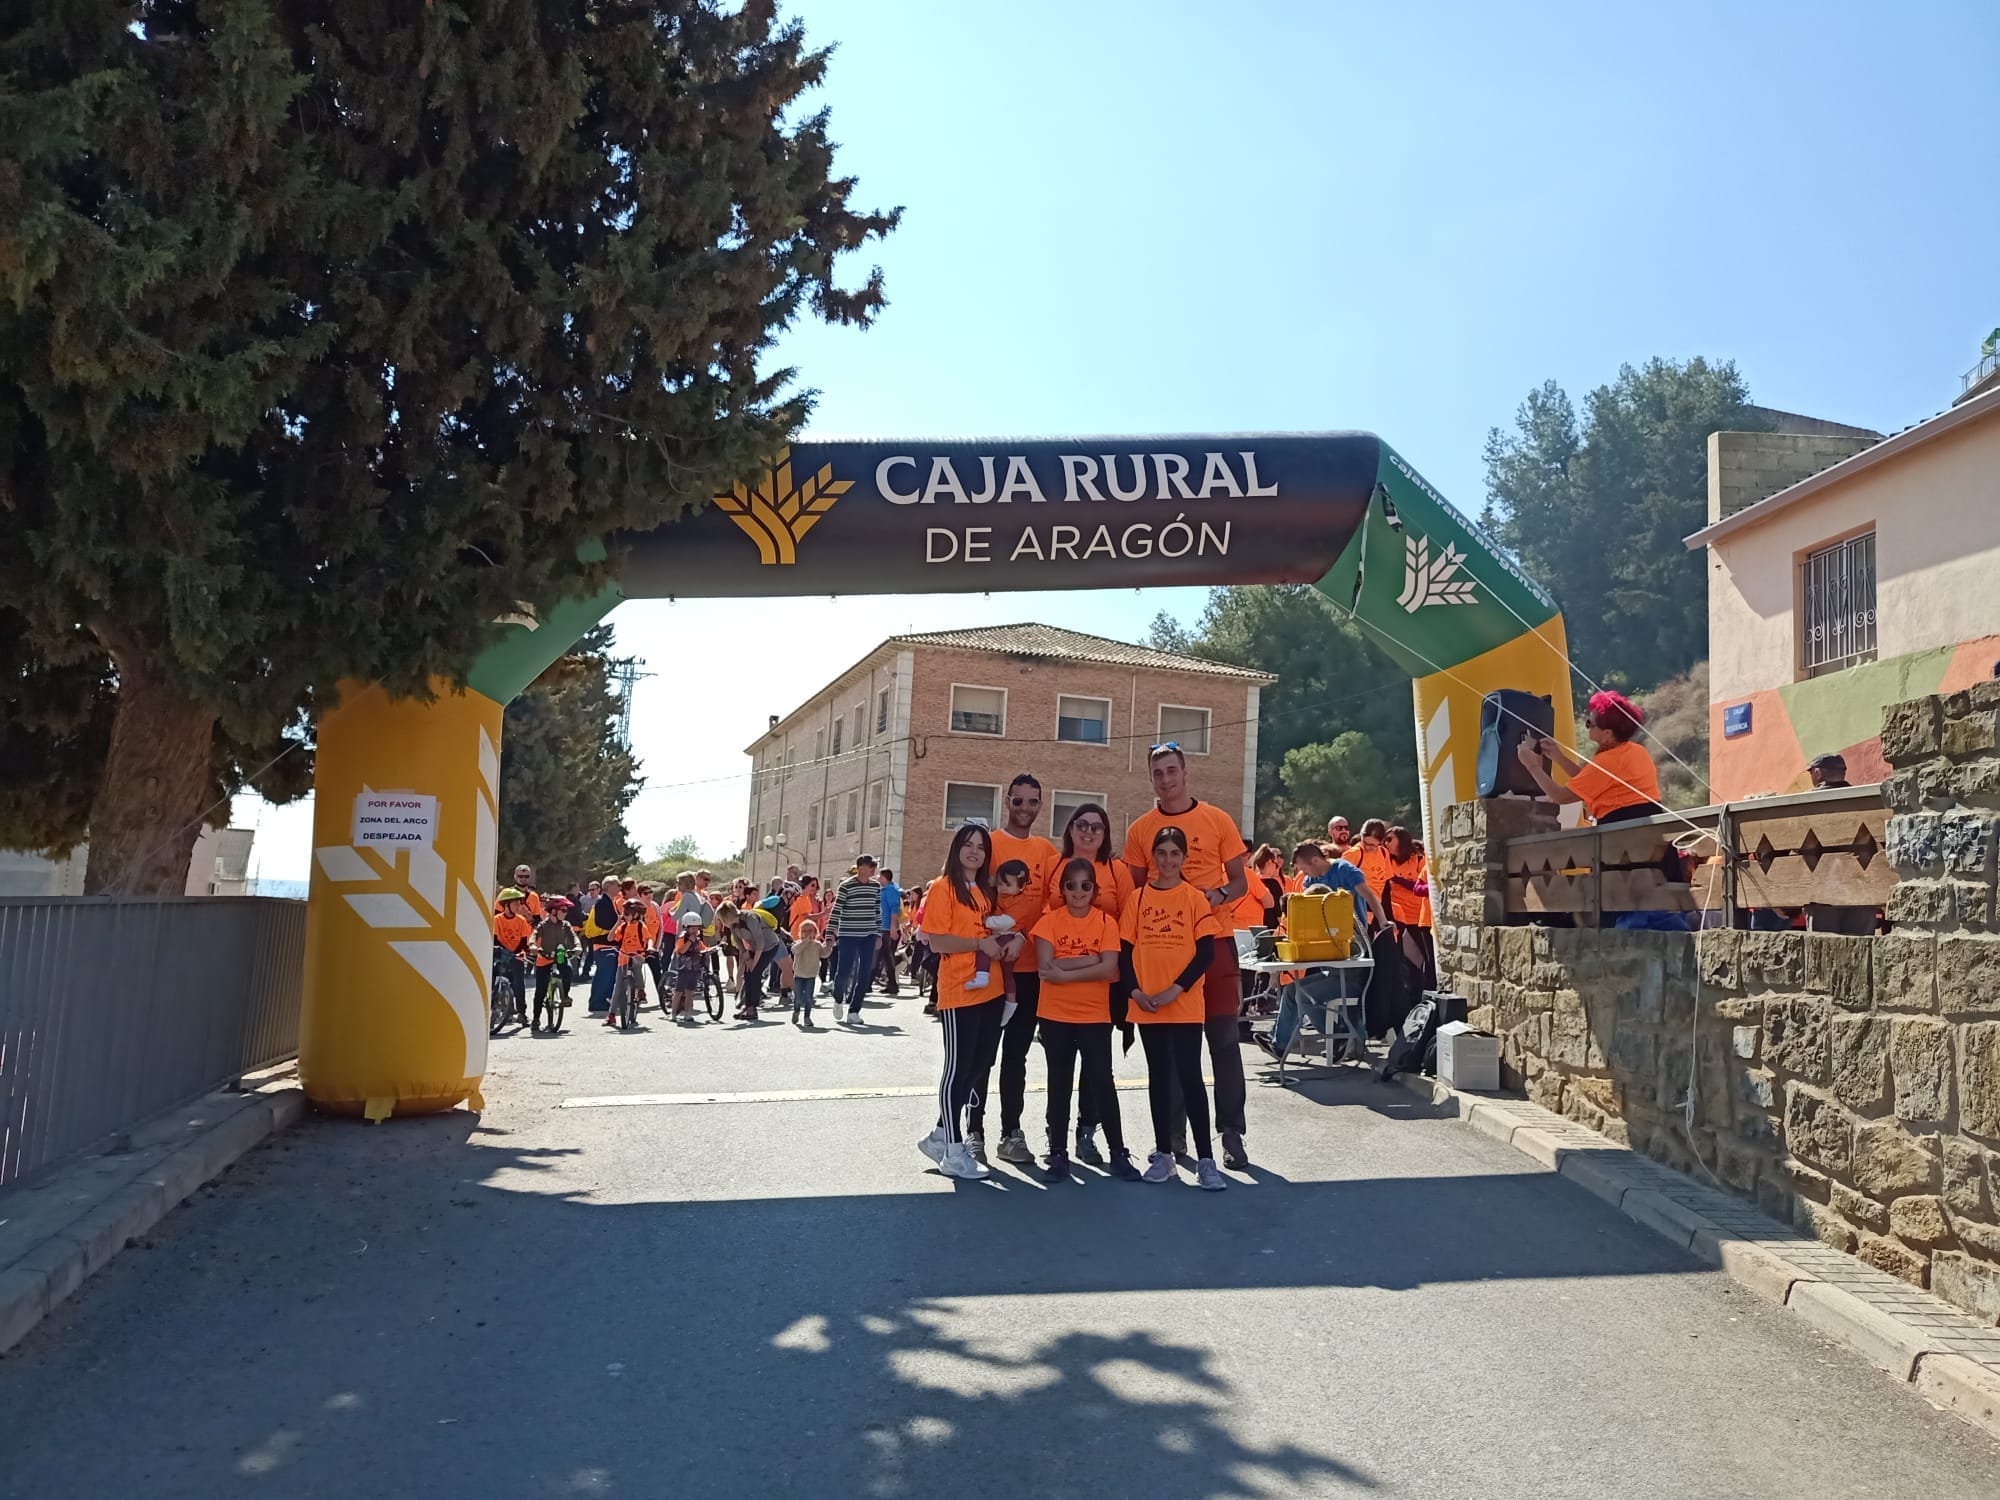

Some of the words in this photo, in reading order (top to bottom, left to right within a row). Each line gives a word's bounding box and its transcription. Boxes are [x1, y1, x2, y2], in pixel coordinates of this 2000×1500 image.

[875, 455, 1045, 505] CAJA
[1059, 450, 1278, 503] RURAL
[925, 526, 992, 563] DE
[1010, 513, 1231, 562] ARAGÓN
[1388, 455, 1550, 608] cajaruraldearagon.es
[368, 800, 387, 808] POR
[389, 801, 422, 809] FAVOR
[359, 816, 382, 824] ZONA
[403, 817, 428, 825] ARCO
[363, 832, 422, 841] DESPEJADA
